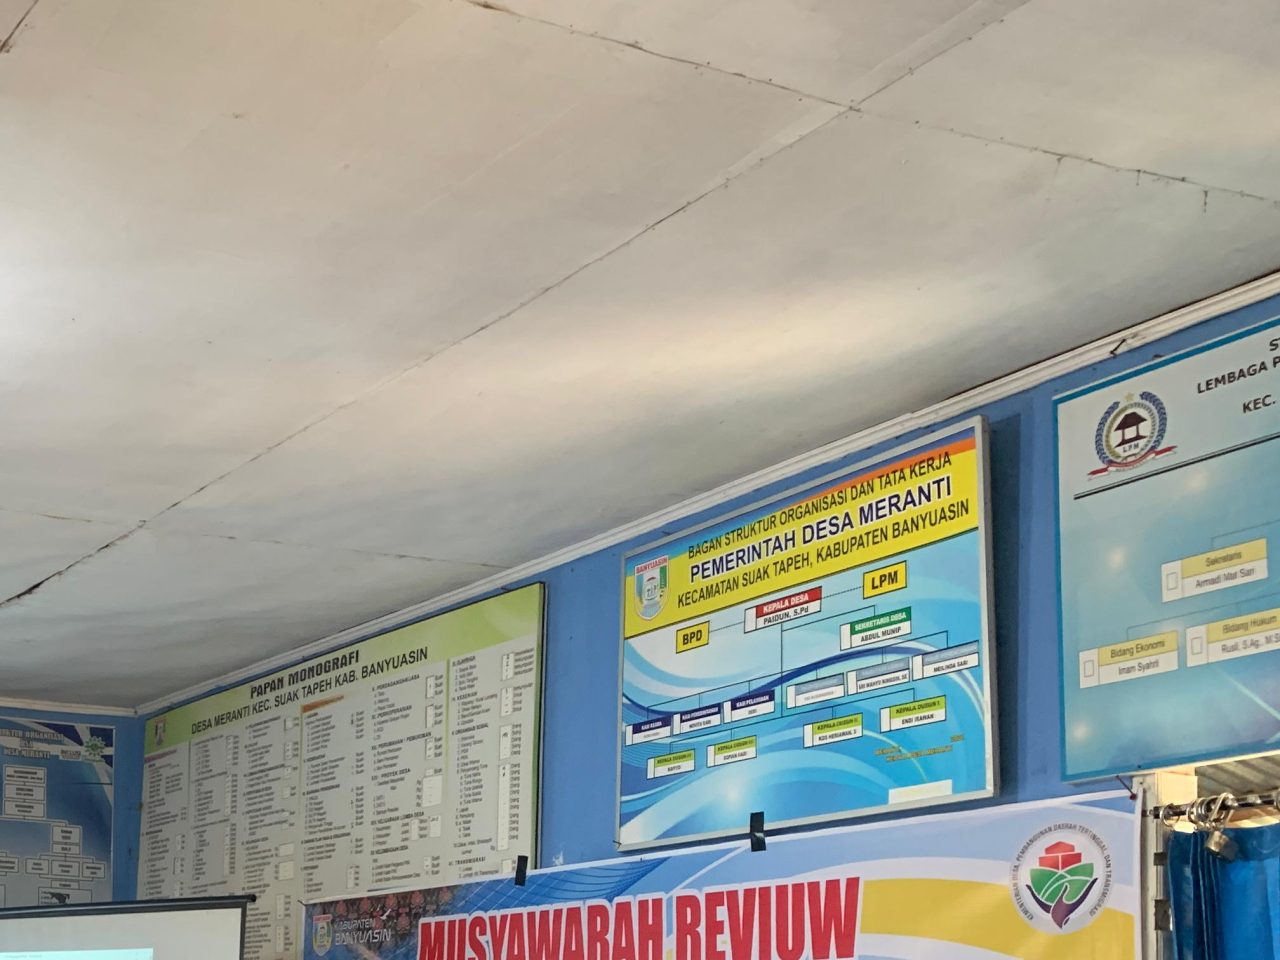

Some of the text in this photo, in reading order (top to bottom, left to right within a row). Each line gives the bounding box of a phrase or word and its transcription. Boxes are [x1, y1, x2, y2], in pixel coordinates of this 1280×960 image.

[1197, 361, 1268, 394] LEMBAGA
[1242, 394, 1276, 414] KEC.
[688, 451, 952, 559] BAGAN STRUKTUR ORGANISASI DAN TATA KERJA
[690, 476, 952, 583] PEMERINTAH DESA MERANTI
[677, 499, 969, 608] KECAMATAN SUAK TAPEH, KABUPATEN BANYUASIN
[871, 570, 899, 590] LPM
[763, 593, 809, 614] KEPALA DESA
[682, 629, 702, 646] BPD
[1223, 621, 1249, 634] Bidang
[1110, 639, 1166, 659] Bidang Ekonomi
[249, 650, 360, 699] PAPAN MONOGRAFI
[191, 717, 213, 735] DESA
[213, 702, 251, 727] MERANTI
[252, 698, 272, 716] KEC.
[274, 690, 299, 708] SUAK
[301, 679, 333, 699] TAPEH
[334, 671, 358, 688] KAB.
[361, 646, 429, 679] BANYUASIN
[335, 928, 392, 945] BANYUASIN
